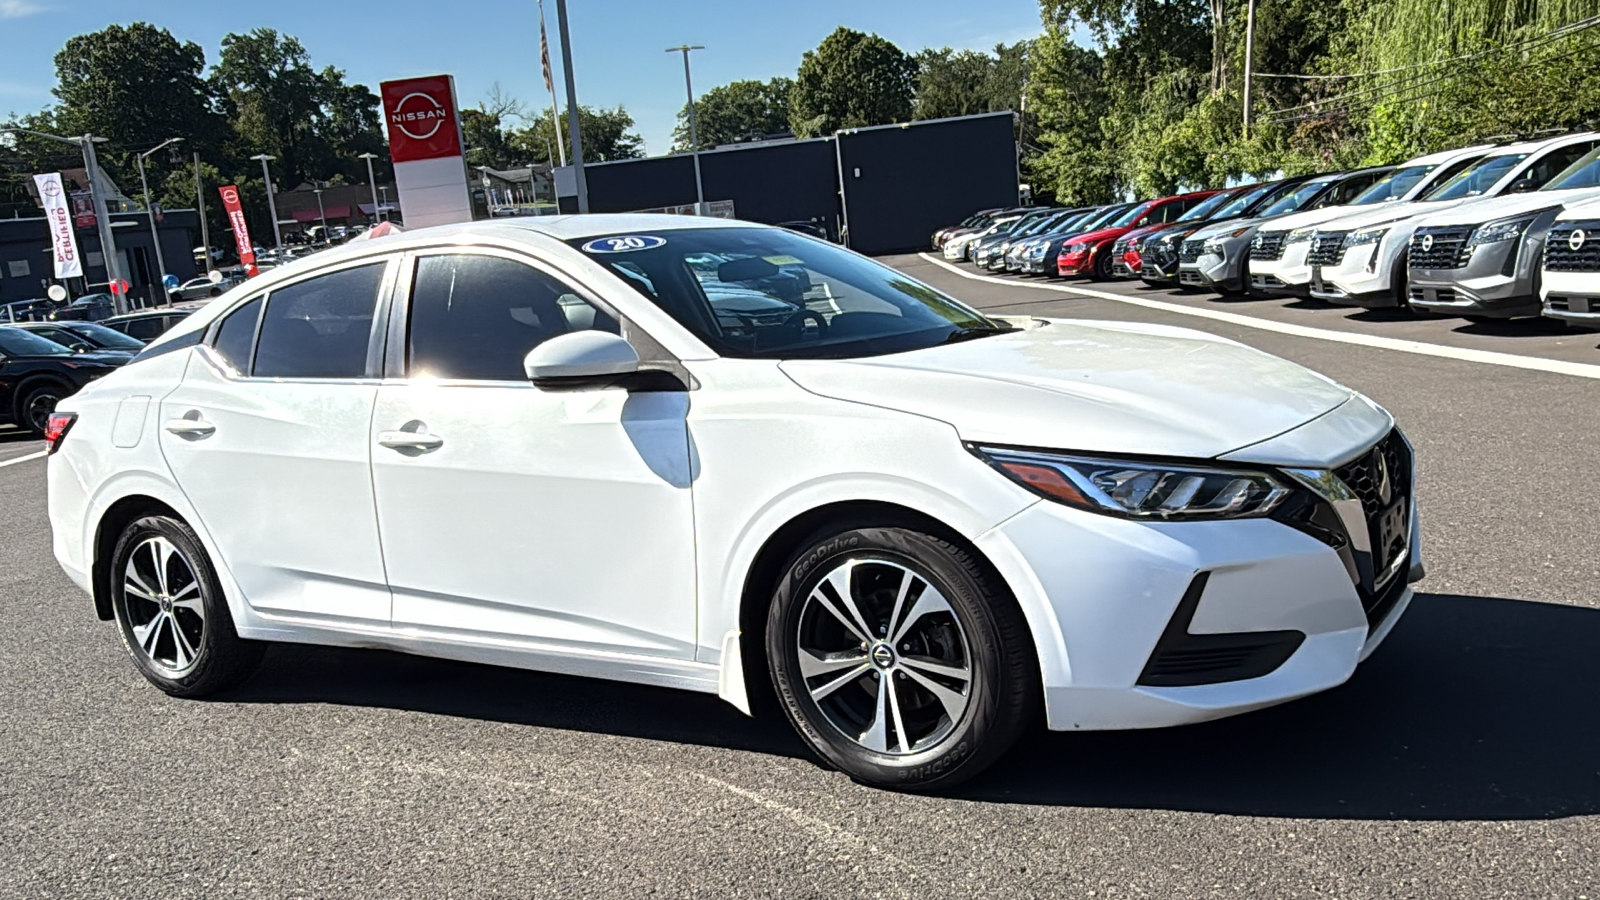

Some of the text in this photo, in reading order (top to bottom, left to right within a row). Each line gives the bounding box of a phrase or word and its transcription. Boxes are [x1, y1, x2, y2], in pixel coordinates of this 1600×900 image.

[391, 108, 446, 123] NISSAN
[607, 237, 646, 251] 20
[794, 536, 858, 580] GeoDrive
[897, 741, 968, 779] GeoDrive
